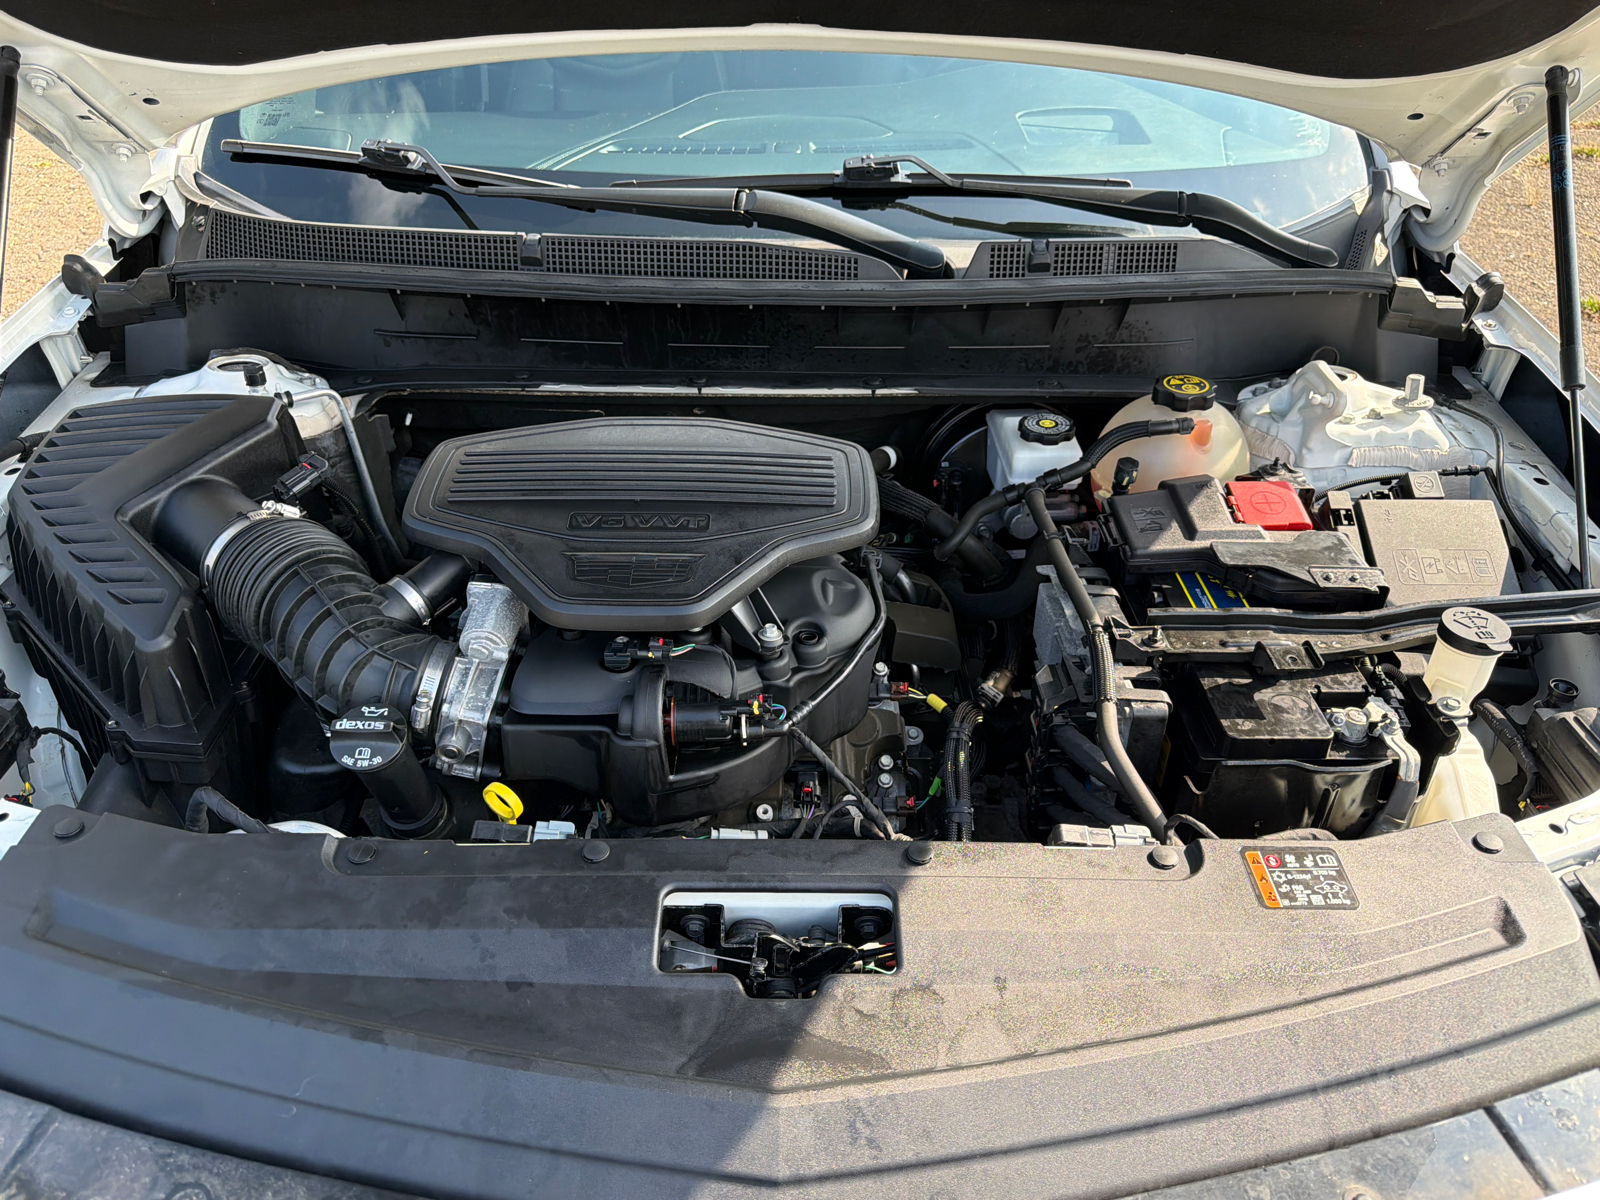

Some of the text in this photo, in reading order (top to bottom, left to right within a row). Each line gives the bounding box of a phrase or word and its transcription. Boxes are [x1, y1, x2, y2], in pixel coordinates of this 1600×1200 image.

[575, 514, 707, 529] V6 VVT
[335, 718, 385, 730] dexos
[341, 755, 383, 768] SAE 5W-30
